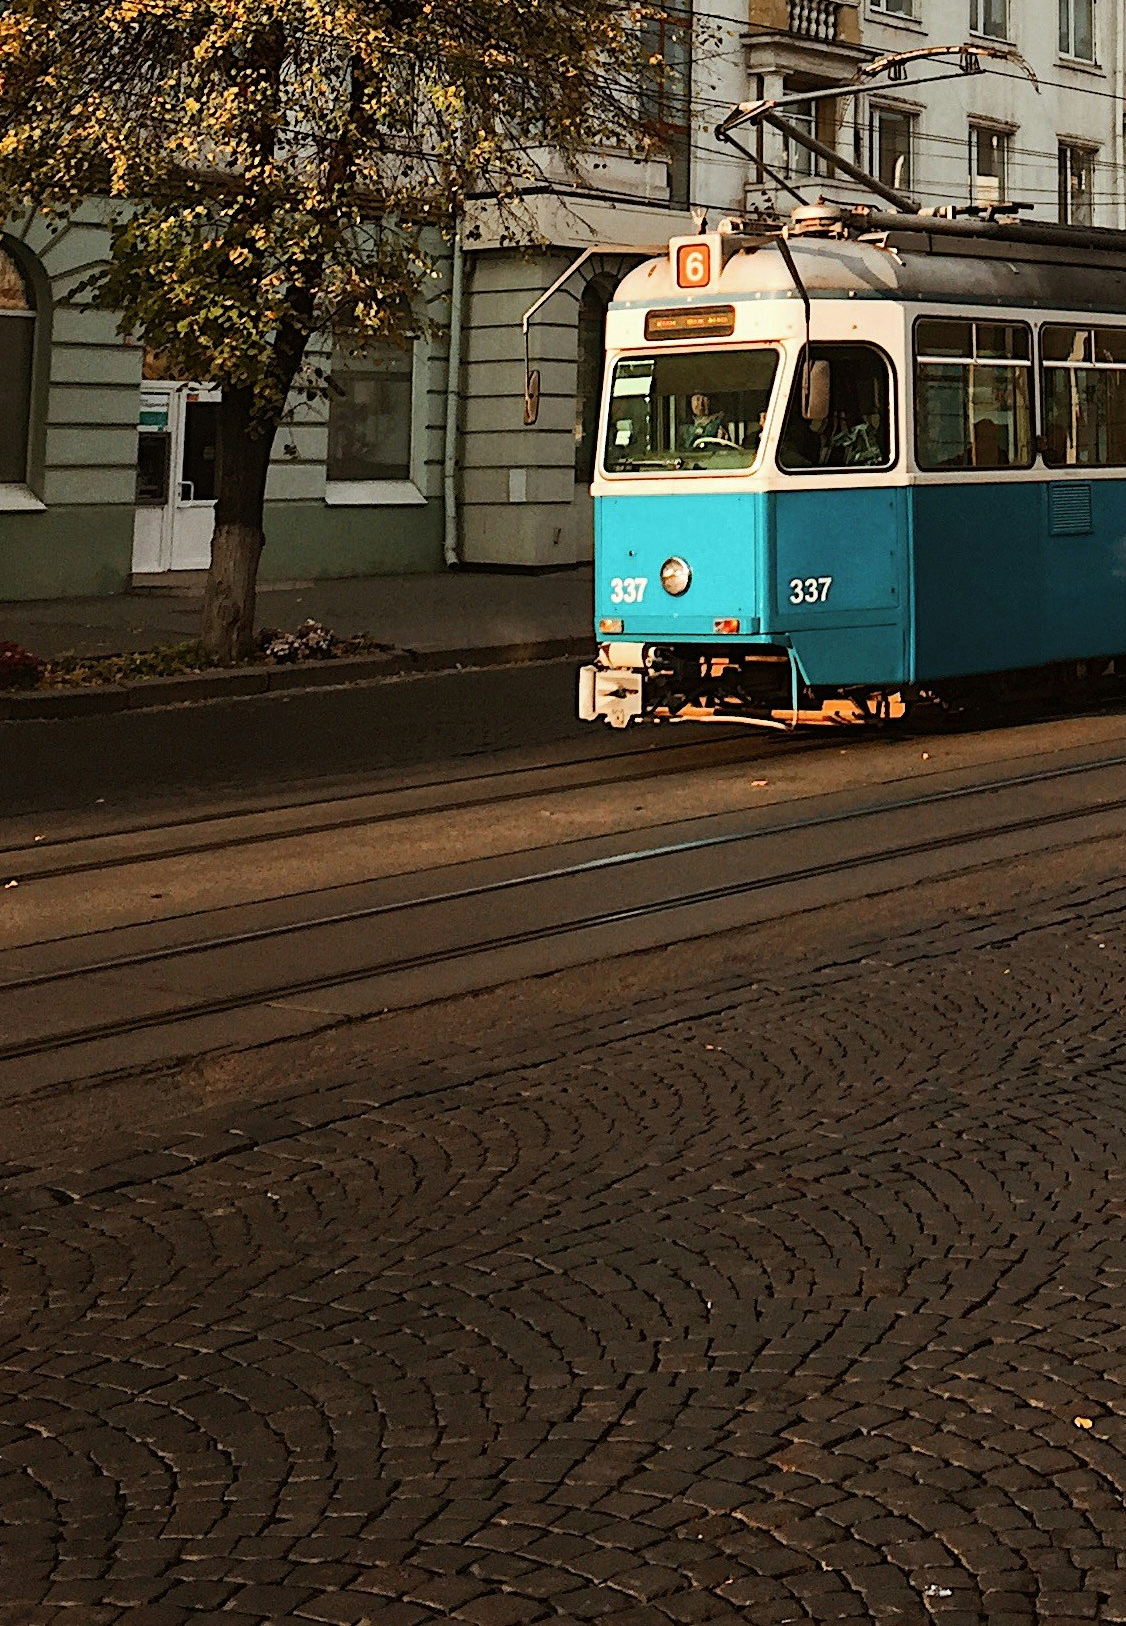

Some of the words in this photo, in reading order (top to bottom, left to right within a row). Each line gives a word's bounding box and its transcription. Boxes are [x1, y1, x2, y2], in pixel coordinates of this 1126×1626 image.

[686, 251, 704, 282] 6
[610, 577, 648, 604] 337
[789, 576, 832, 604] 337
